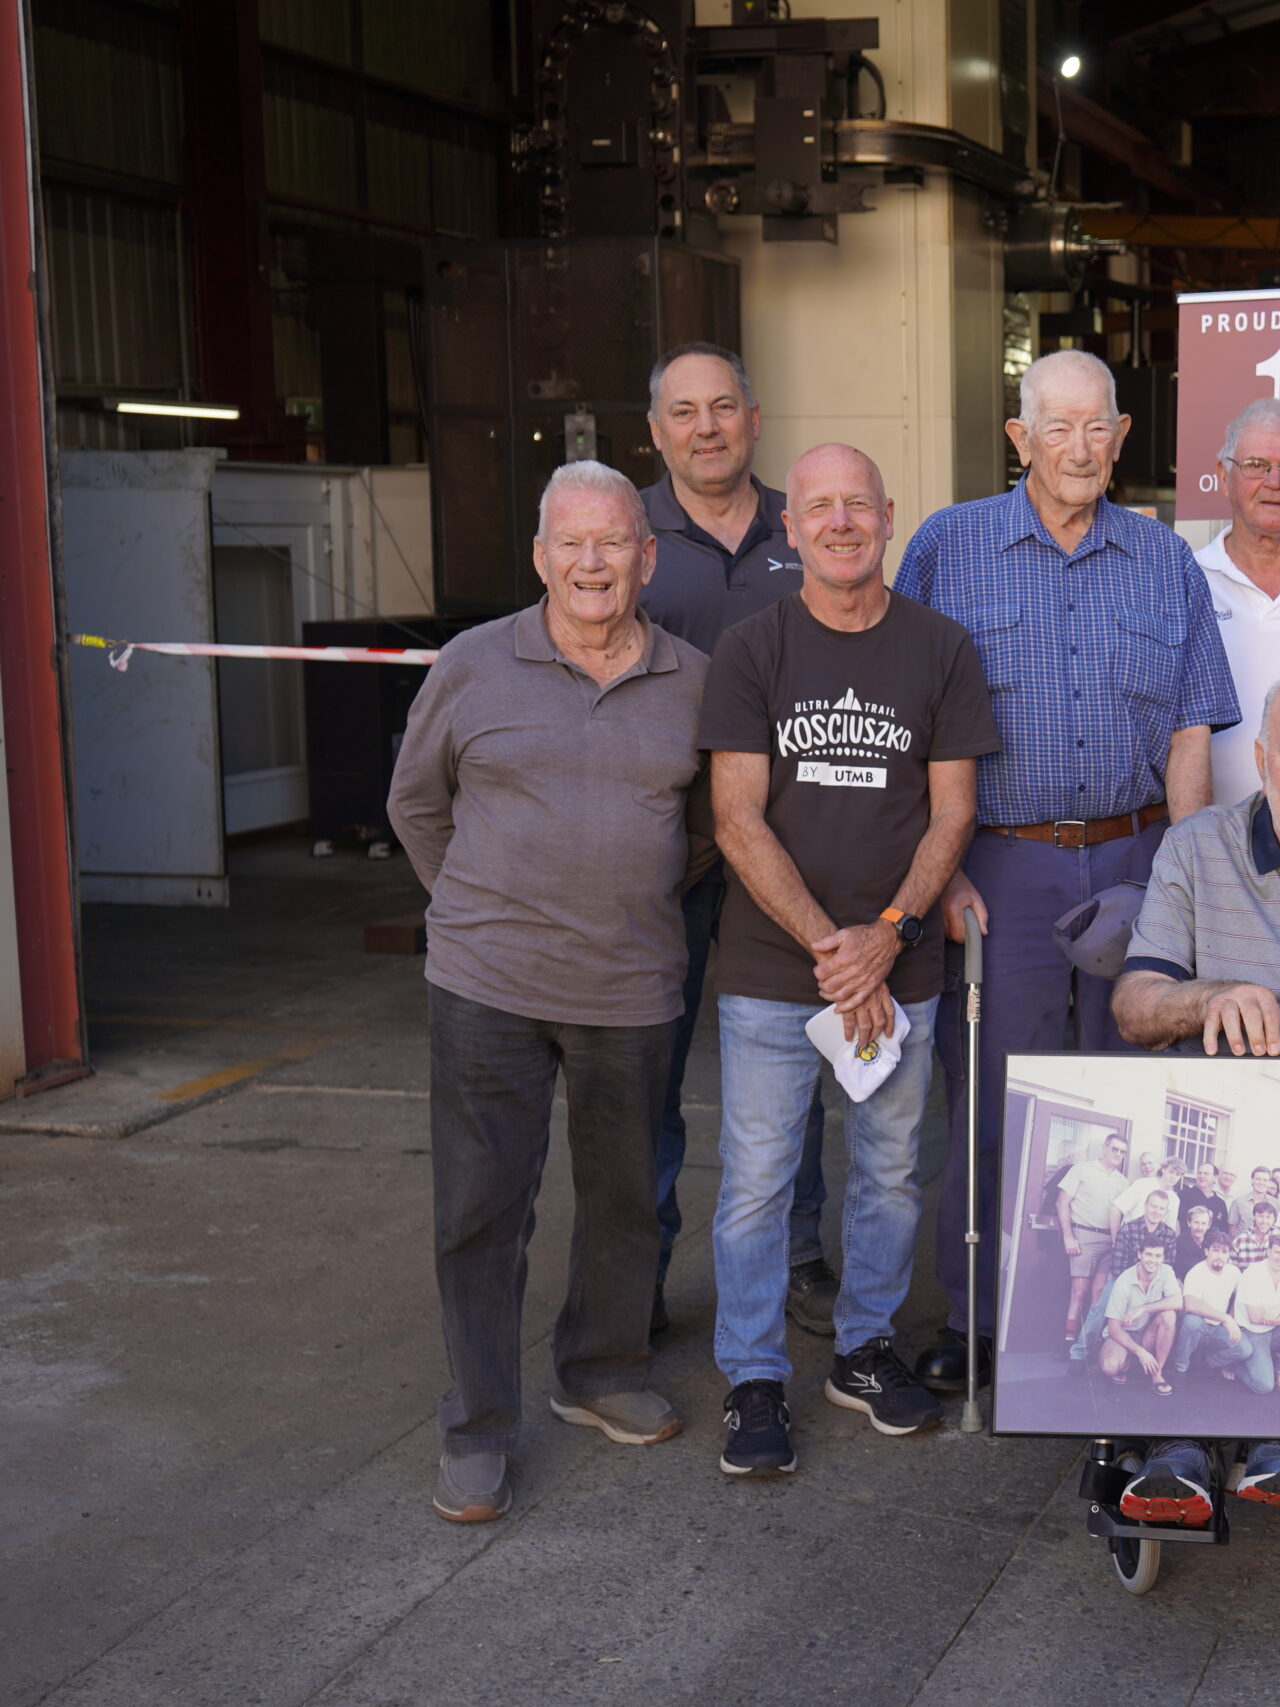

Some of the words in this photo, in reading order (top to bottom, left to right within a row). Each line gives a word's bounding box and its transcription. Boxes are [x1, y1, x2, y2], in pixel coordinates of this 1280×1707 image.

[795, 700, 829, 713] ULTRA
[864, 702, 896, 718] TRAIL
[776, 713, 912, 757] KOSCIUSZKO
[802, 766, 818, 777] BY
[835, 770, 874, 783] UTMB
